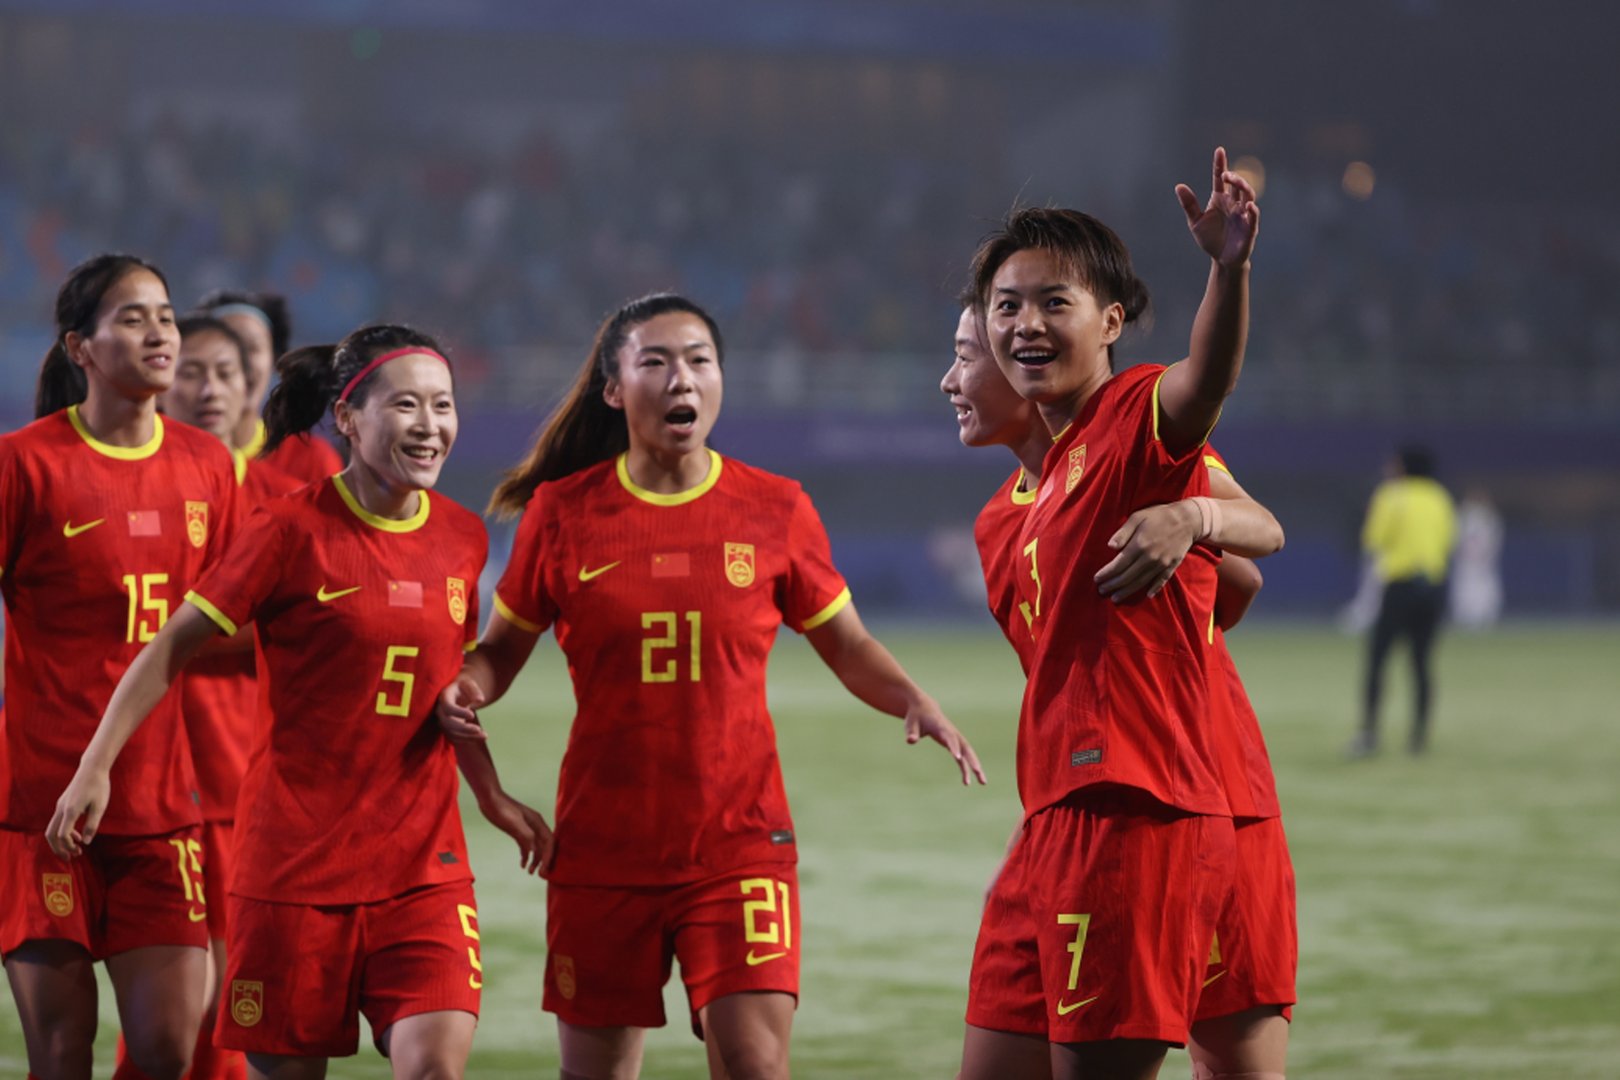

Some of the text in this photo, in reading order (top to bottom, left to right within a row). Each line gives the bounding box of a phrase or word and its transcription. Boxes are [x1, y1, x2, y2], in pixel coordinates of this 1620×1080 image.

[122, 573, 169, 644] 15
[375, 645, 419, 718] 5
[641, 611, 701, 683] 21
[168, 838, 206, 905] 15
[457, 904, 482, 972] 5
[740, 878, 791, 949] 21
[1057, 913, 1091, 990] 7
